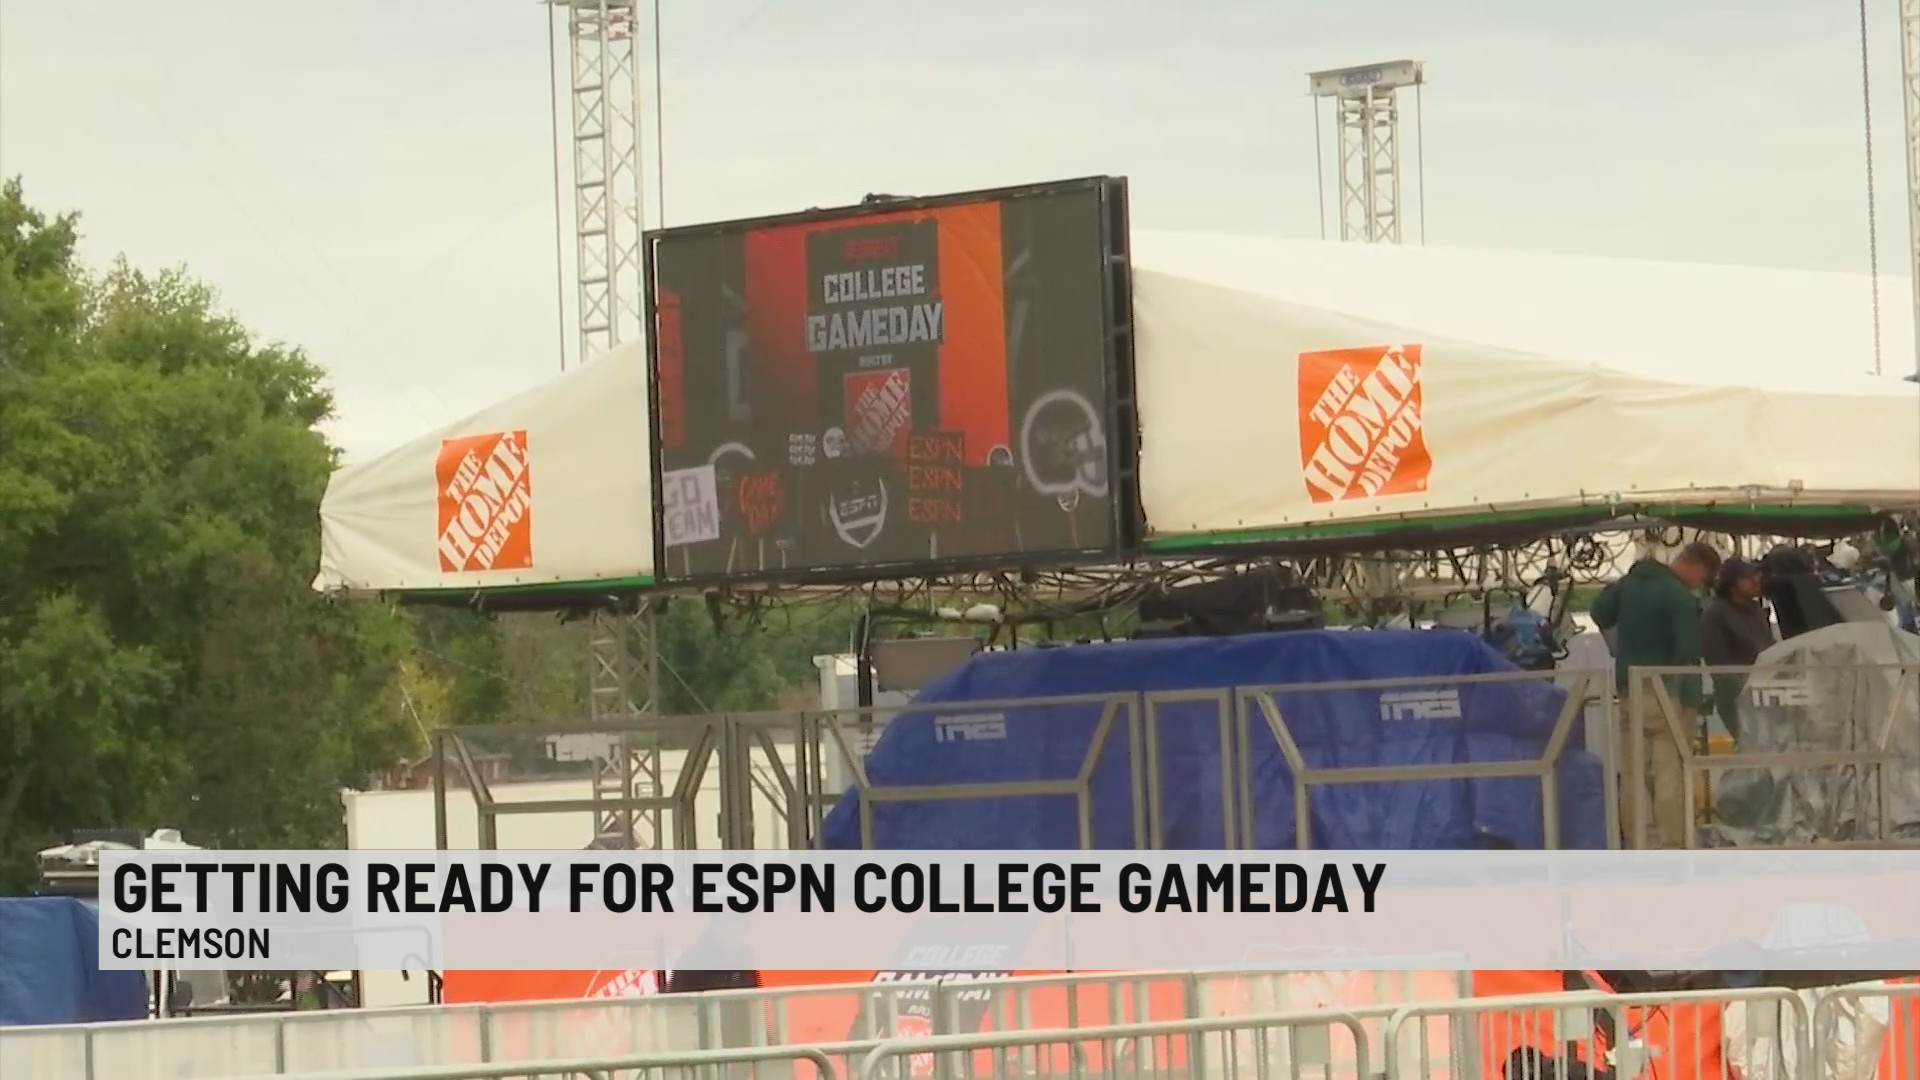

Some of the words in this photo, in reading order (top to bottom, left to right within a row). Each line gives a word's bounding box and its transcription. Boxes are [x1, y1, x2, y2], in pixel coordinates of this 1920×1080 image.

[823, 264, 926, 304] COLLEGE
[807, 303, 943, 352] GAMEDAY
[1309, 364, 1360, 428] THE
[1303, 344, 1420, 500] HOME
[909, 435, 962, 460] ESPN
[1357, 400, 1421, 497] DEPOT
[445, 449, 482, 504] THE
[909, 466, 962, 490] ESPN
[438, 432, 529, 571] HOME
[668, 500, 715, 540] EAM
[840, 495, 877, 516] ESPN
[908, 497, 961, 522] ESPN
[473, 481, 531, 570] DEPOT
[902, 944, 1009, 969] COLLEGE
